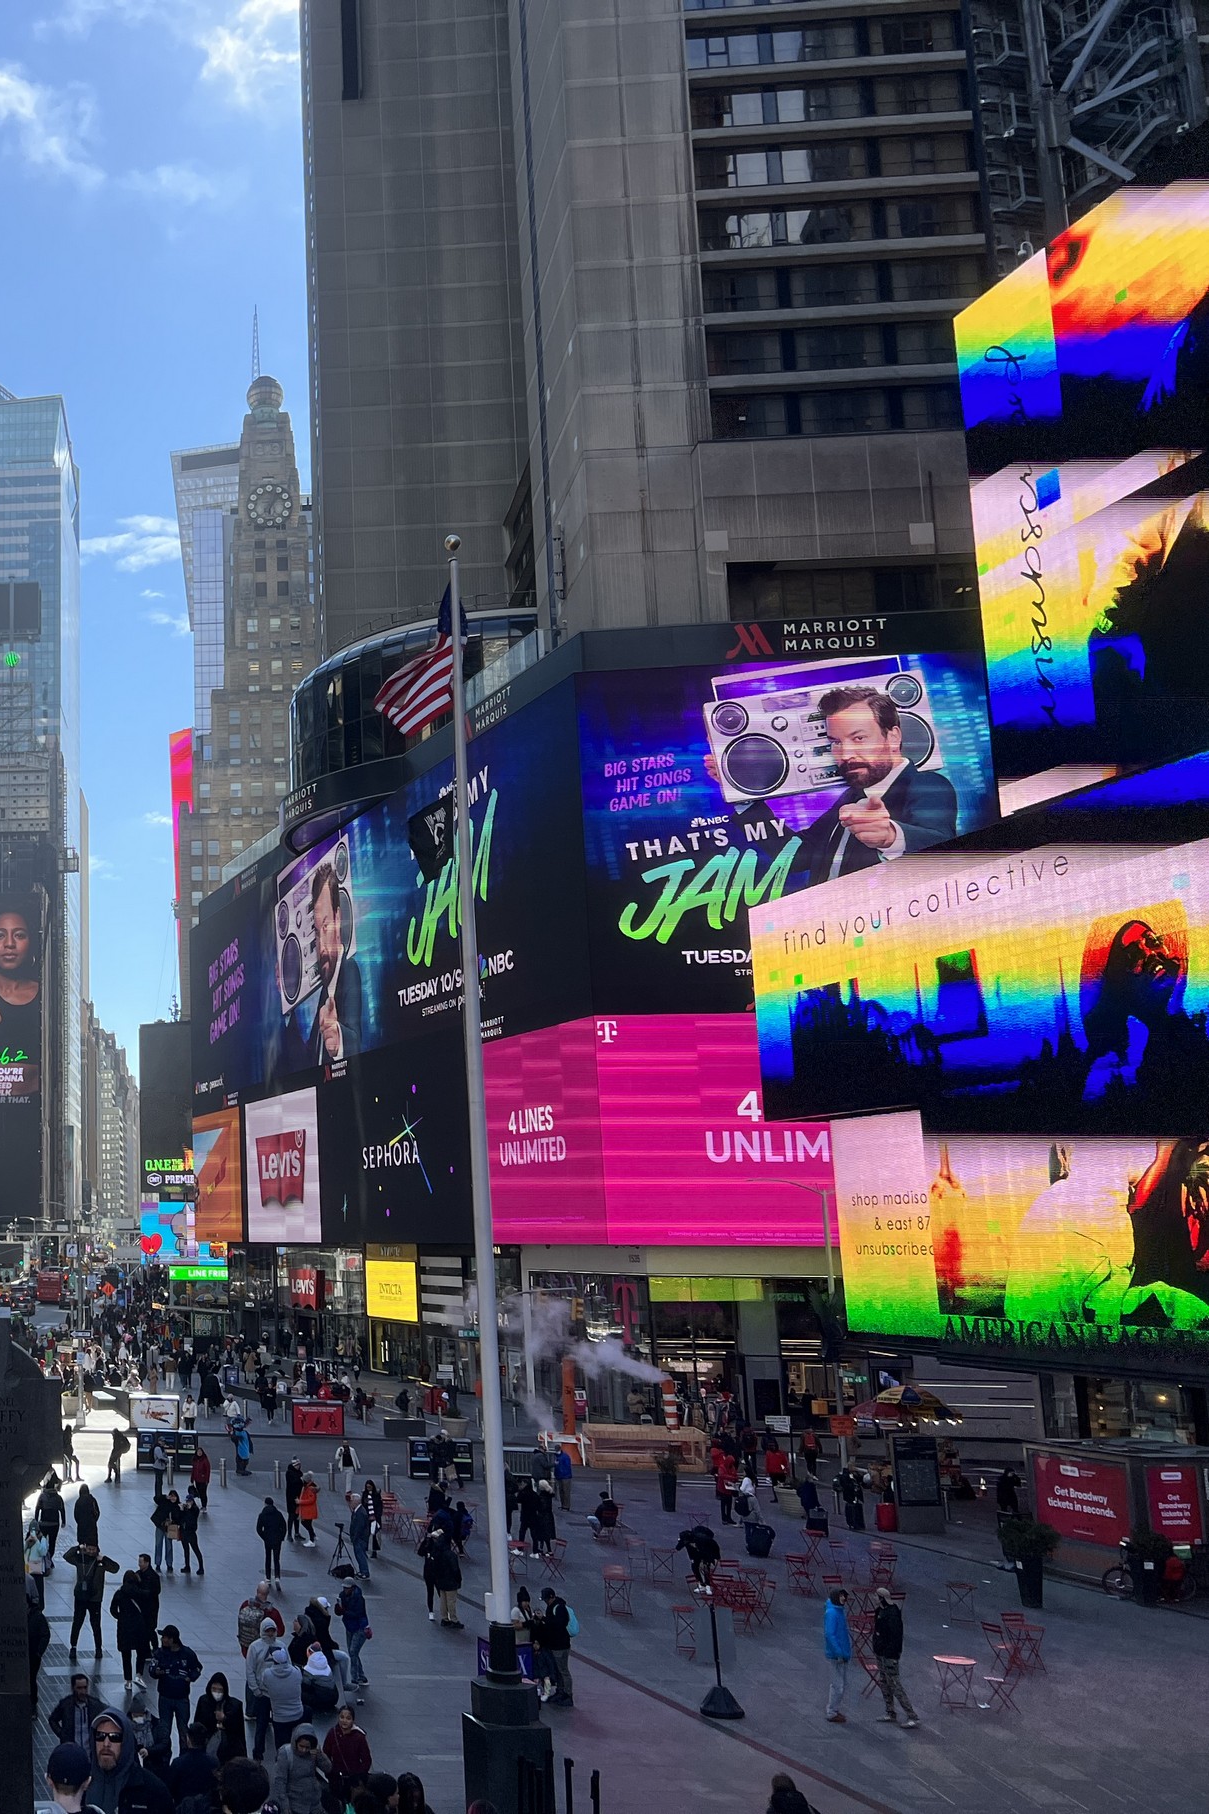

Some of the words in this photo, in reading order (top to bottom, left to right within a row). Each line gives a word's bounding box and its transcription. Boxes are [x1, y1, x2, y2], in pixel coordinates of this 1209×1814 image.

[783, 618, 888, 635] MARRIOTT
[783, 634, 878, 651] MARQUIS
[475, 686, 511, 718] MARRIOTT
[475, 704, 508, 733] MARQUIS
[604, 761, 627, 777] BIG
[632, 753, 675, 773] STARS
[616, 777, 639, 793] HIT
[644, 768, 691, 789] SONGS
[609, 794, 651, 812] GAME
[657, 788, 682, 805] ON!
[706, 815, 730, 825] NBC
[625, 828, 729, 861] THAT'S
[744, 818, 786, 842] MY
[618, 835, 803, 945] JAM
[784, 920, 827, 955] find
[839, 902, 894, 940] your
[908, 853, 1070, 919] collective
[488, 949, 514, 976] NBC
[682, 950, 752, 965] TUESDA
[208, 959, 219, 989] BIG
[212, 984, 222, 1013] HIT
[398, 977, 439, 1007] TUESDAY
[422, 1000, 448, 1017] STREAMING
[449, 998, 457, 1008] ON
[209, 1010, 227, 1045] GAME
[228, 996, 241, 1028] ON!
[737, 1090, 762, 1122] 4
[507, 1111, 517, 1135] 4
[519, 1104, 554, 1135] LINES
[362, 1140, 421, 1170] SEPHORA
[499, 1135, 567, 1168] UNLIMITED
[705, 1130, 830, 1163] UNLIM
[165, 1174, 195, 1184] PREMIE
[851, 1193, 879, 1207] shop
[883, 1190, 928, 1205] madiso
[874, 1217, 883, 1230] &
[887, 1216, 912, 1231] east
[188, 1269, 206, 1277] LINE
[469, 1311, 509, 1327] SERA
[1054, 1485, 1069, 1498] Get
[1070, 1488, 1108, 1505] Broadway
[1158, 1502, 1191, 1511] Broadway
[1048, 1497, 1073, 1511] tickets
[1074, 1501, 1082, 1512] in
[1083, 1504, 1117, 1519] seconds.
